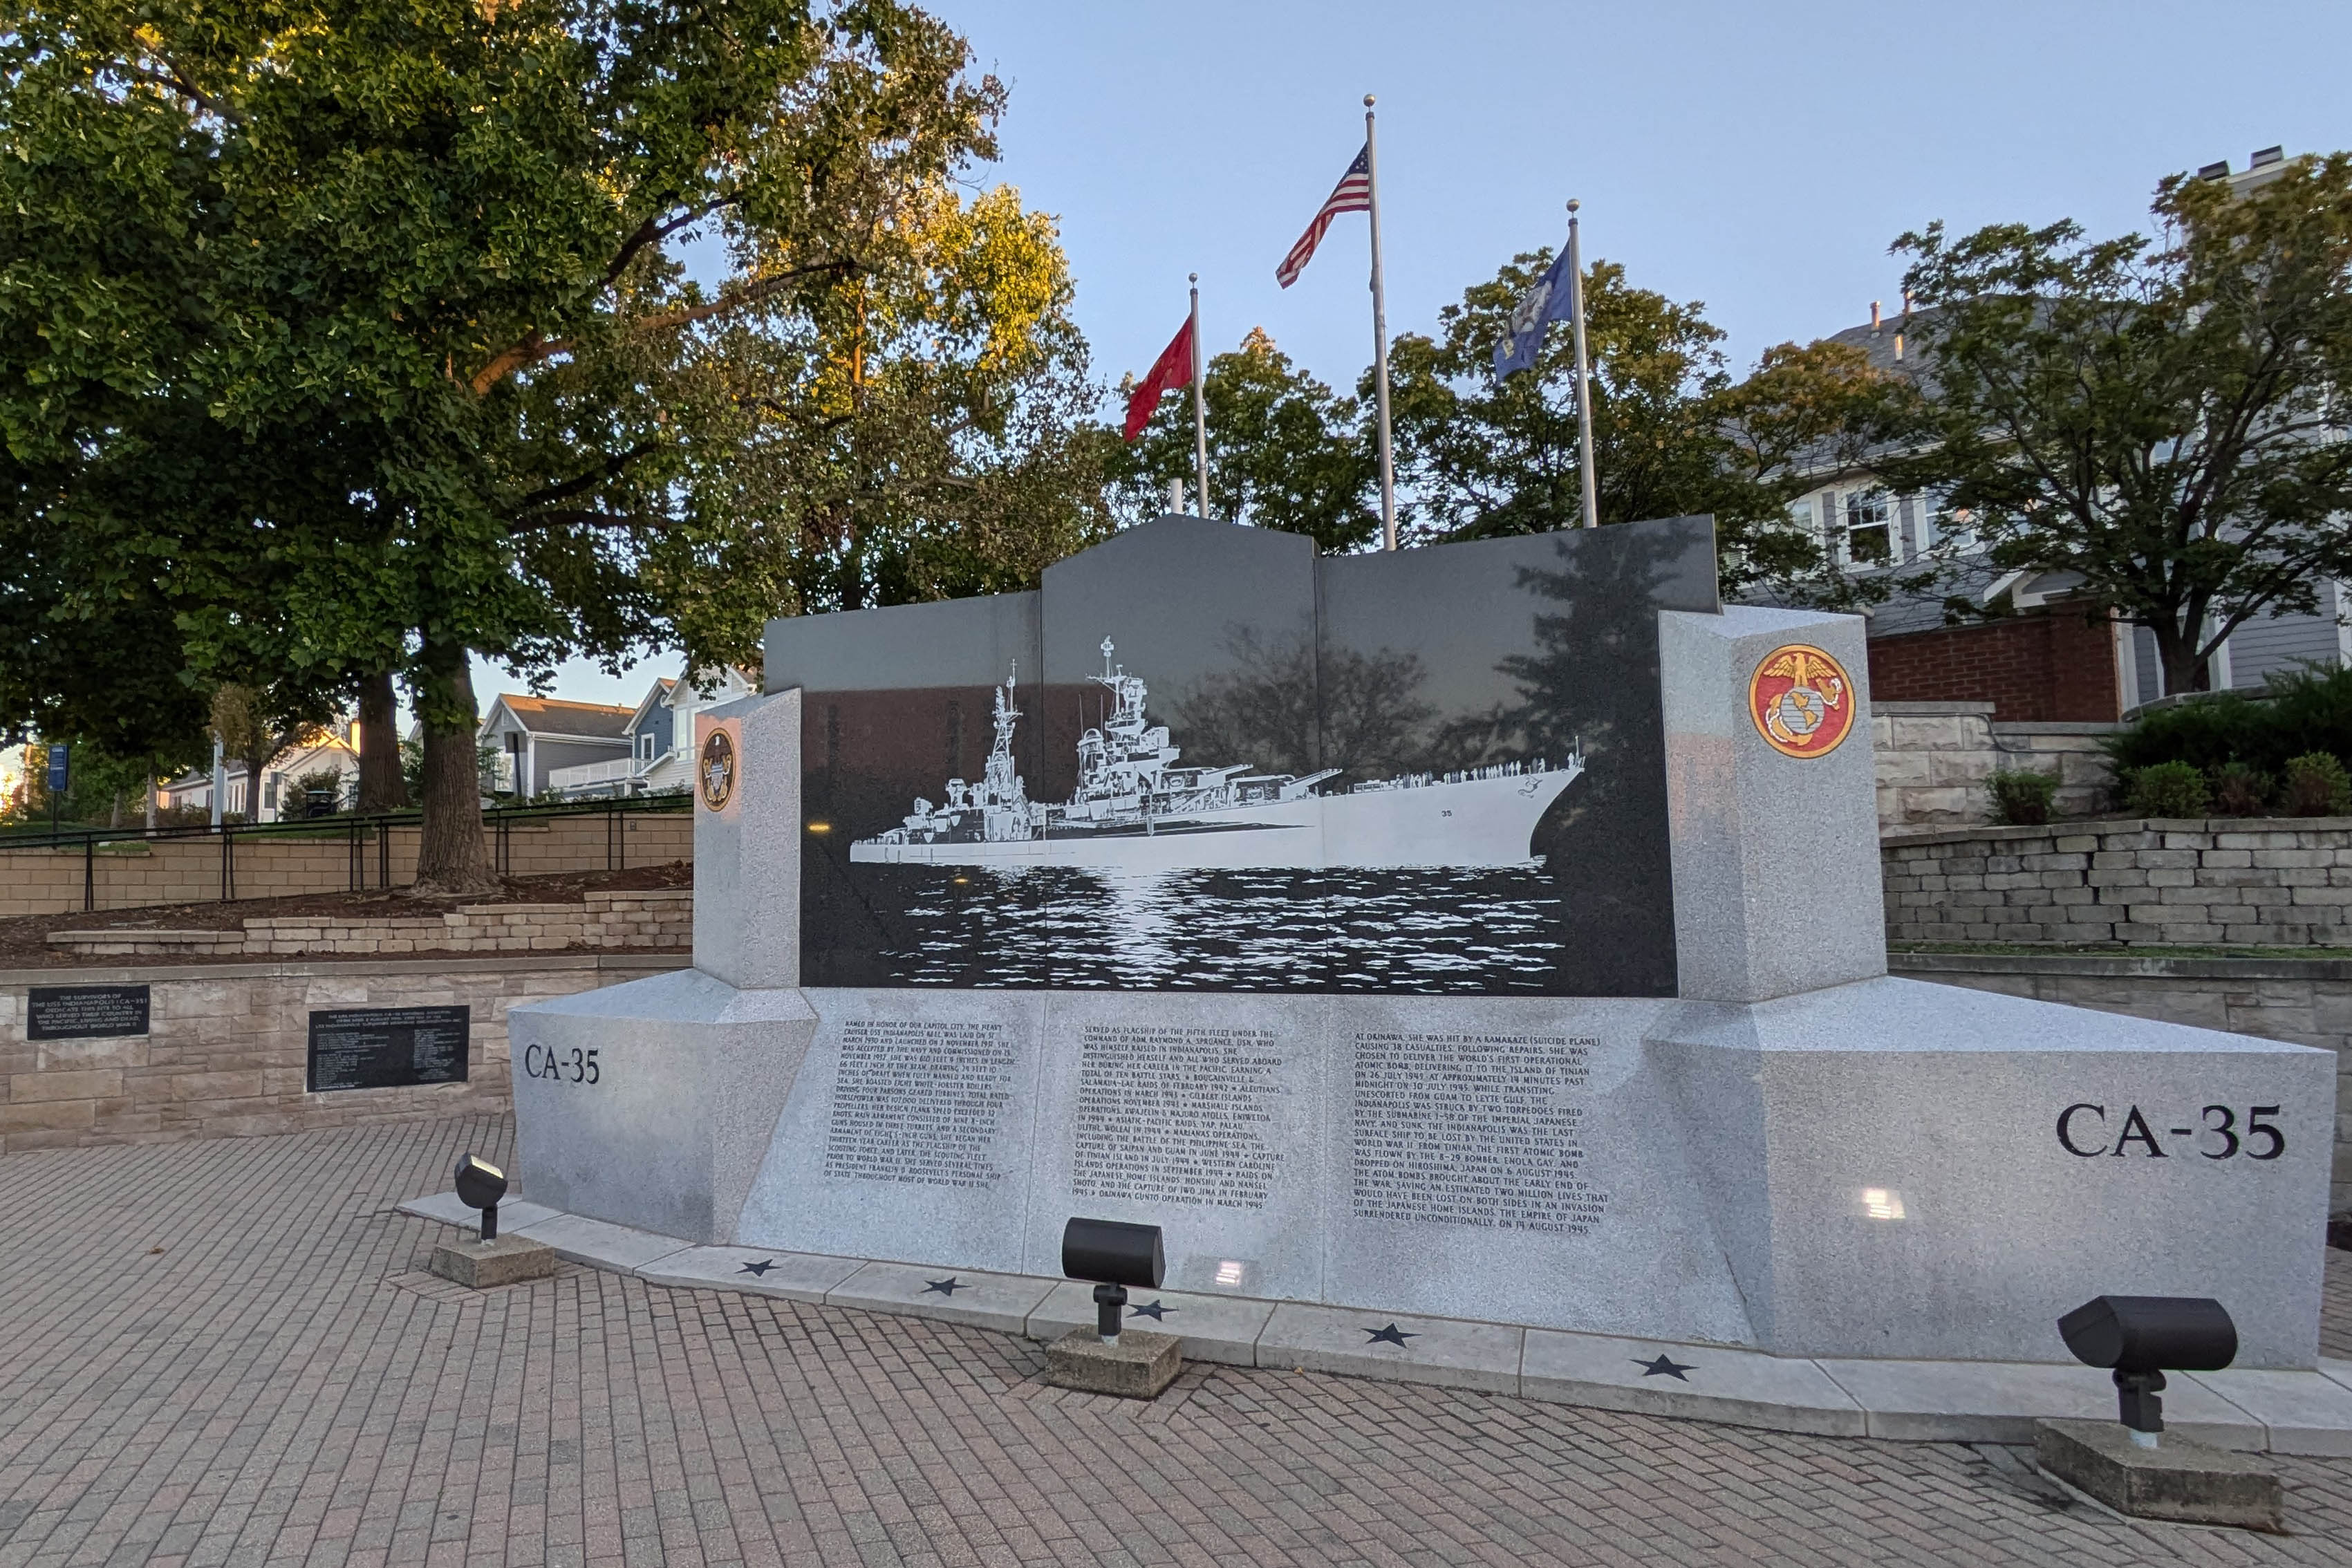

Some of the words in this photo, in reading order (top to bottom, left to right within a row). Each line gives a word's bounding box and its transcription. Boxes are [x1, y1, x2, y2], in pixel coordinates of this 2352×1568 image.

[525, 1044, 599, 1084] CA-35
[1523, 1056, 1580, 1064] OPERATIONAL
[1355, 1100, 1410, 1109] INDIANAPOLIS
[1505, 1105, 1553, 1114] TORPEDOES
[1386, 1111, 1431, 1119] SUBMARINE
[1491, 1115, 1530, 1123] IMPERIAL
[1533, 1117, 1576, 1125] JAPANESE
[1354, 1129, 1388, 1137] SURFACE
[1499, 1136, 1530, 1144] UNITED
[1534, 1137, 1564, 1146] STATES
[2056, 1103, 2285, 1160] CA-35
[1443, 1143, 1472, 1151] TINIAN
[1523, 1147, 1554, 1155] ATOMIC
[1558, 1149, 1584, 1157] BOMB
[1398, 1171, 1425, 1179] BOMBS
[1429, 1173, 1470, 1182] BROUGHT
[1471, 1175, 1499, 1184] ABOUT
[1524, 1178, 1551, 1187] EARLY
[1354, 1189, 1383, 1197] WOULD
[1476, 1197, 1498, 1205] BOTH
[1503, 1198, 1527, 1207] SIDES
[1561, 1202, 1604, 1211] INVASION
